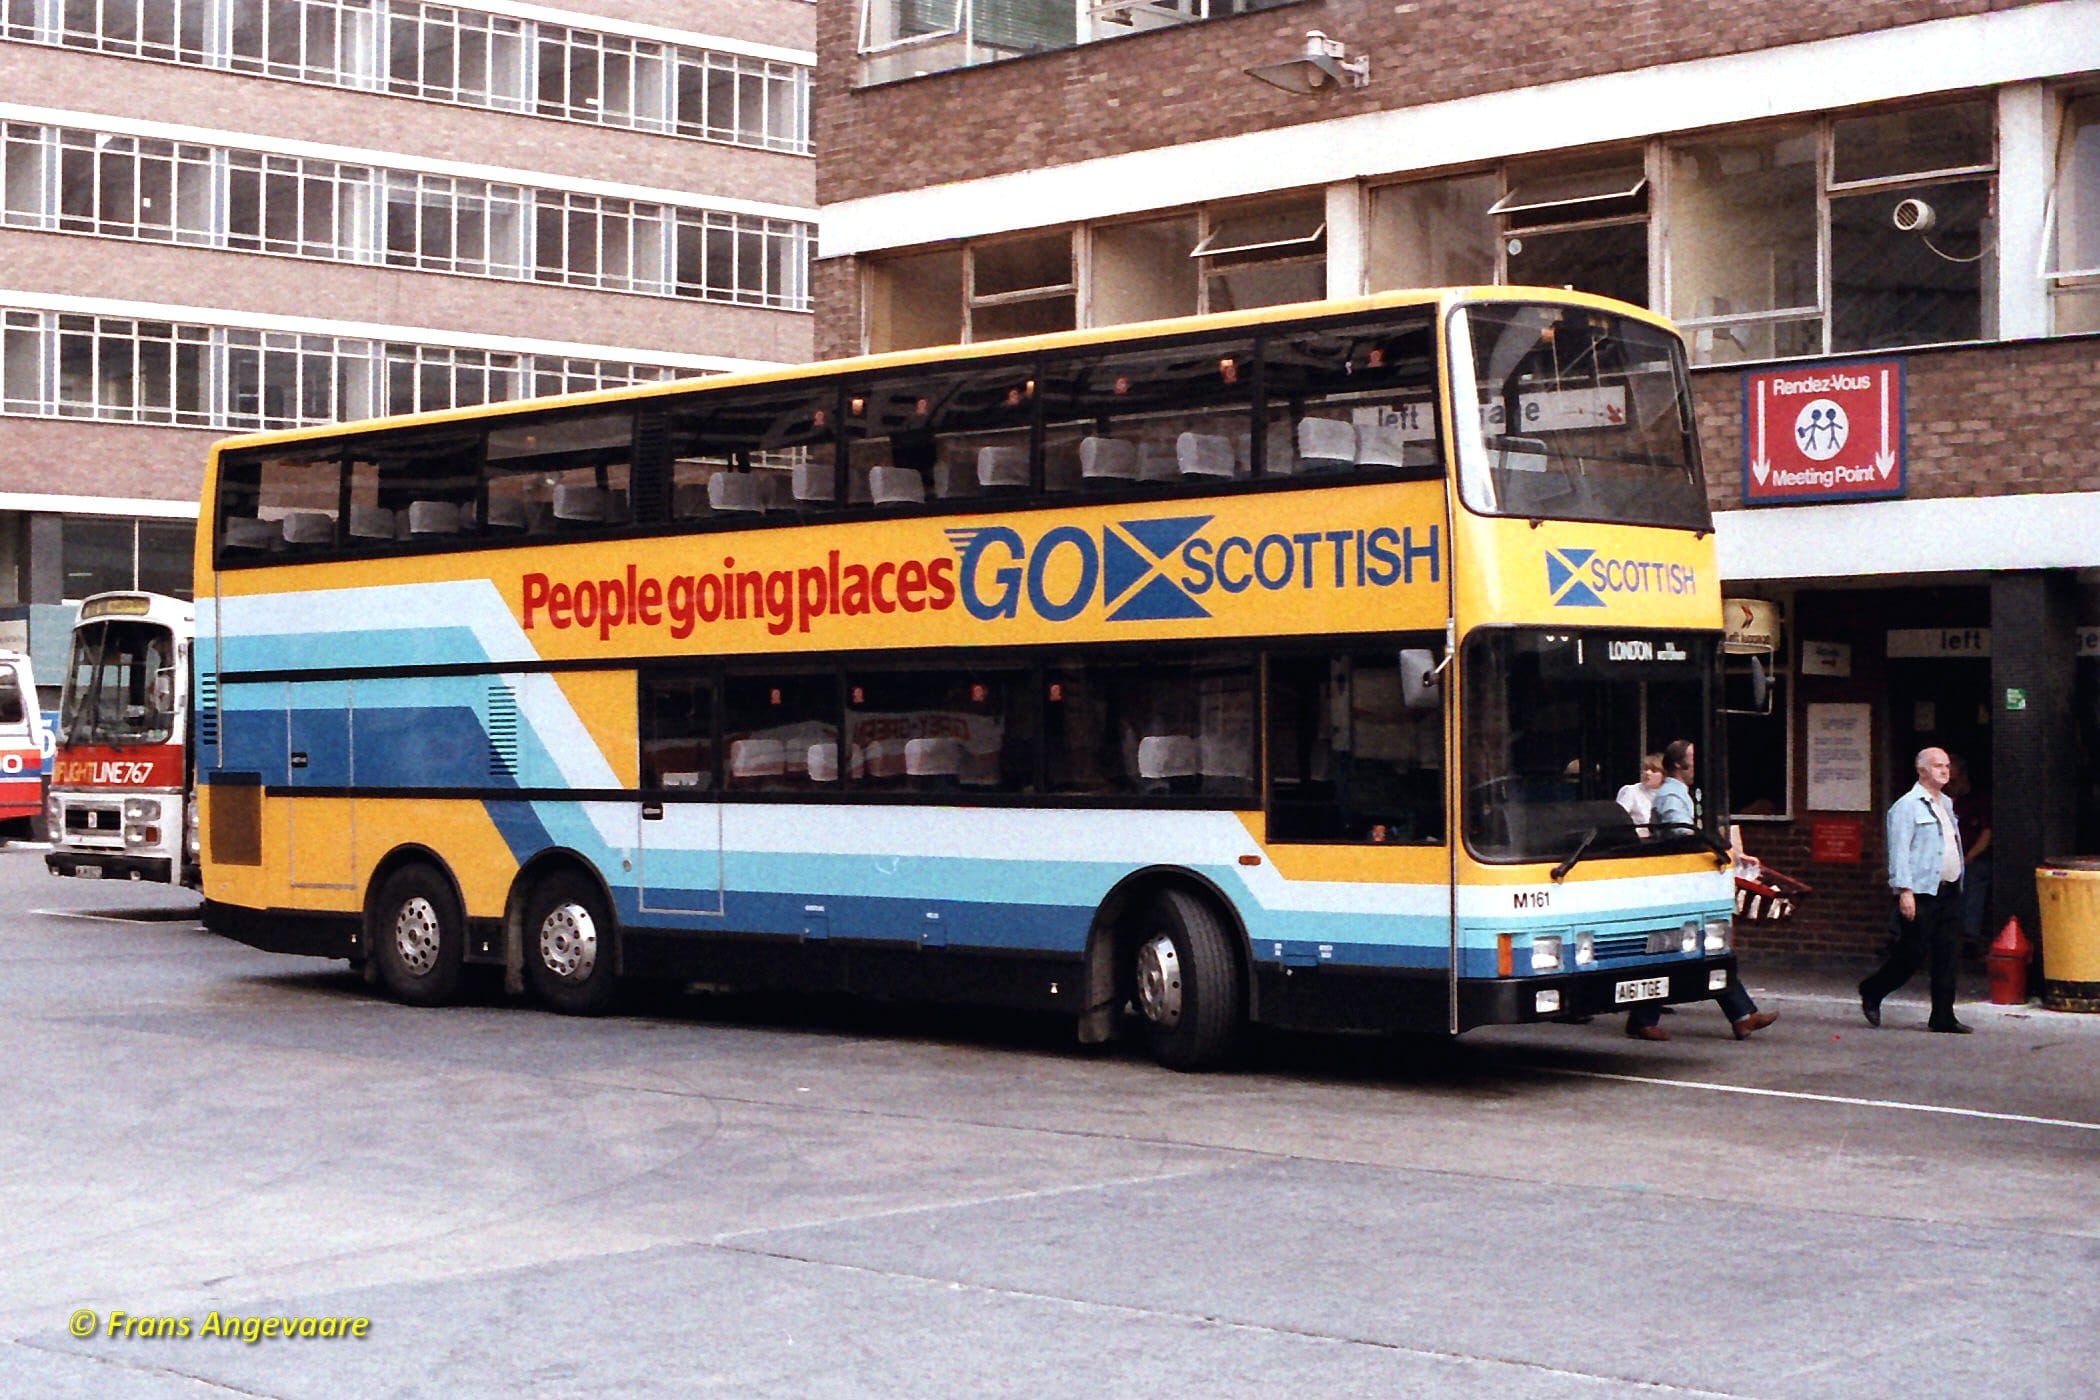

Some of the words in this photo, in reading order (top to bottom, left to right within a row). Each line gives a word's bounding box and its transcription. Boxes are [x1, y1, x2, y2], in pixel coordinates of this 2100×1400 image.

[1773, 373, 1871, 396] Rendez-Vous
[1772, 468, 1834, 488] Meeting
[1834, 466, 1875, 482] Point
[521, 564, 660, 640] People
[669, 556, 796, 640] going
[799, 549, 956, 634] places
[944, 526, 1100, 622] GO
[1181, 524, 1440, 595] SCOTTISH
[1591, 558, 1696, 596] SCOTTISH
[1608, 640, 1653, 661] LONDON
[1941, 630, 1982, 650] left
[0, 754, 23, 774] O
